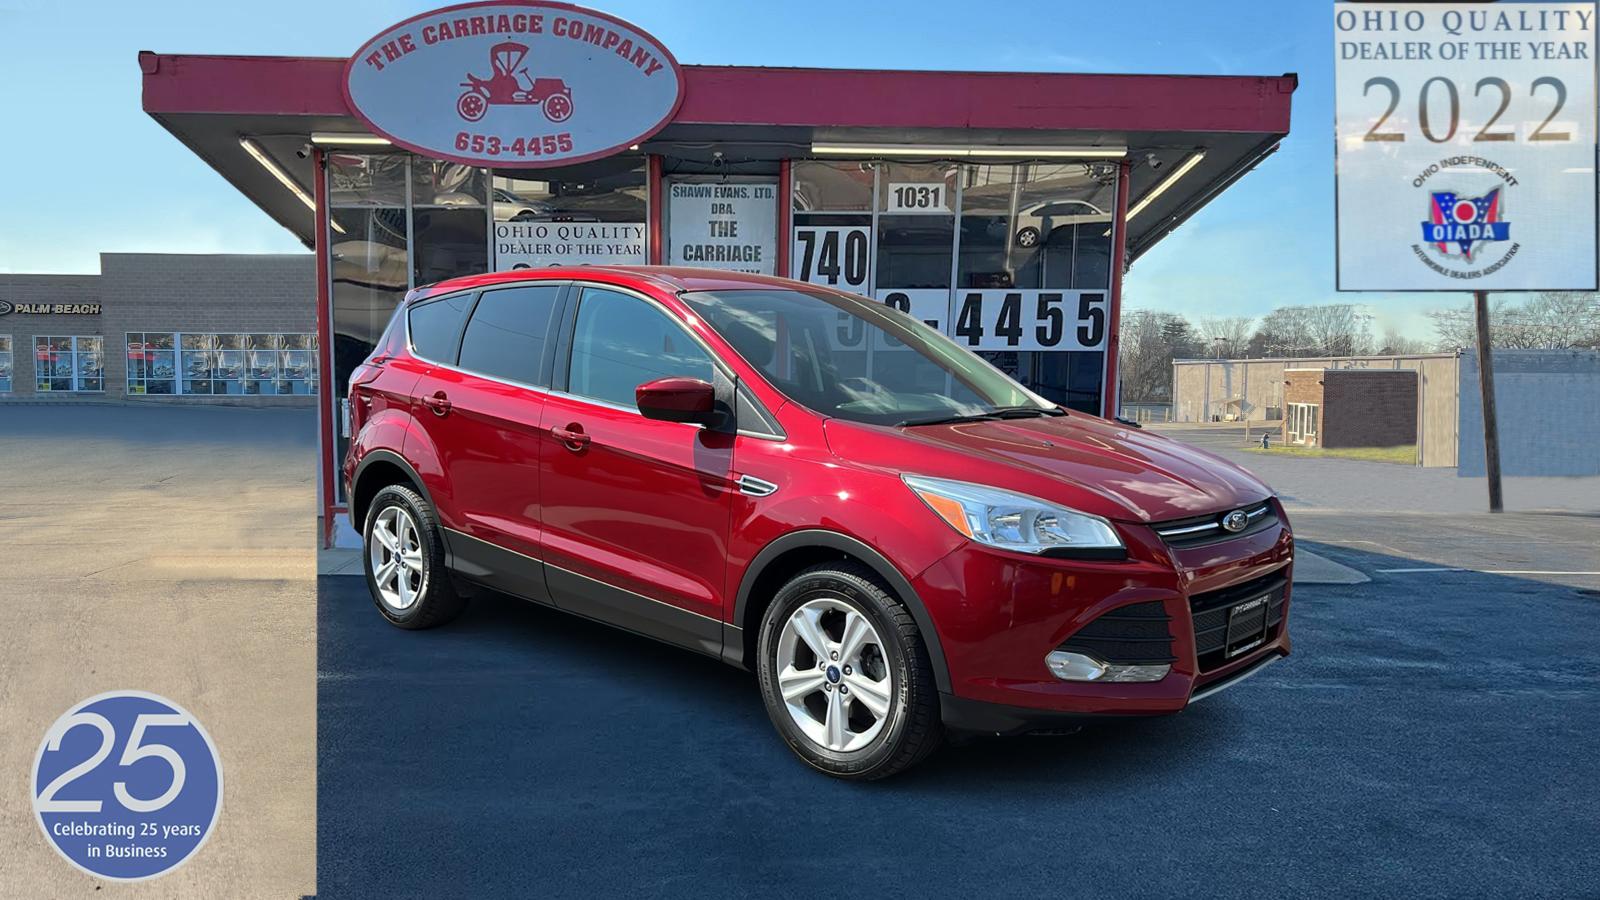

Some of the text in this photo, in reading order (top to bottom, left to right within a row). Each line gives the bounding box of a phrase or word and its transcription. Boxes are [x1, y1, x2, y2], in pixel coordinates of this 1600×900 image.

[1336, 10, 1593, 36] OHIO QUALITY
[365, 14, 664, 77] THE CARRIAGE COMPANY
[1340, 42, 1589, 60] DEALER OF THE YEAR
[1362, 76, 1571, 143] 2022
[455, 132, 573, 156] 653-4455
[1413, 156, 1519, 188] OHIO INDEPENDENT
[672, 185, 712, 198] SHAWN
[754, 187, 775, 199] LTD.
[894, 186, 941, 208] 1031
[711, 203, 736, 215] DBA.
[497, 226, 644, 241] OHIO QUALITY
[708, 221, 738, 238] THE
[1432, 225, 1495, 240] OIADA
[500, 243, 642, 255] DEALER OF THE YEAR
[683, 244, 762, 262] CARRIAGE
[797, 229, 868, 286] 740
[1411, 242, 1520, 280] AUTOMOBILE DEALERS ASSOCIATION
[14, 303, 100, 314] PALM BEACH
